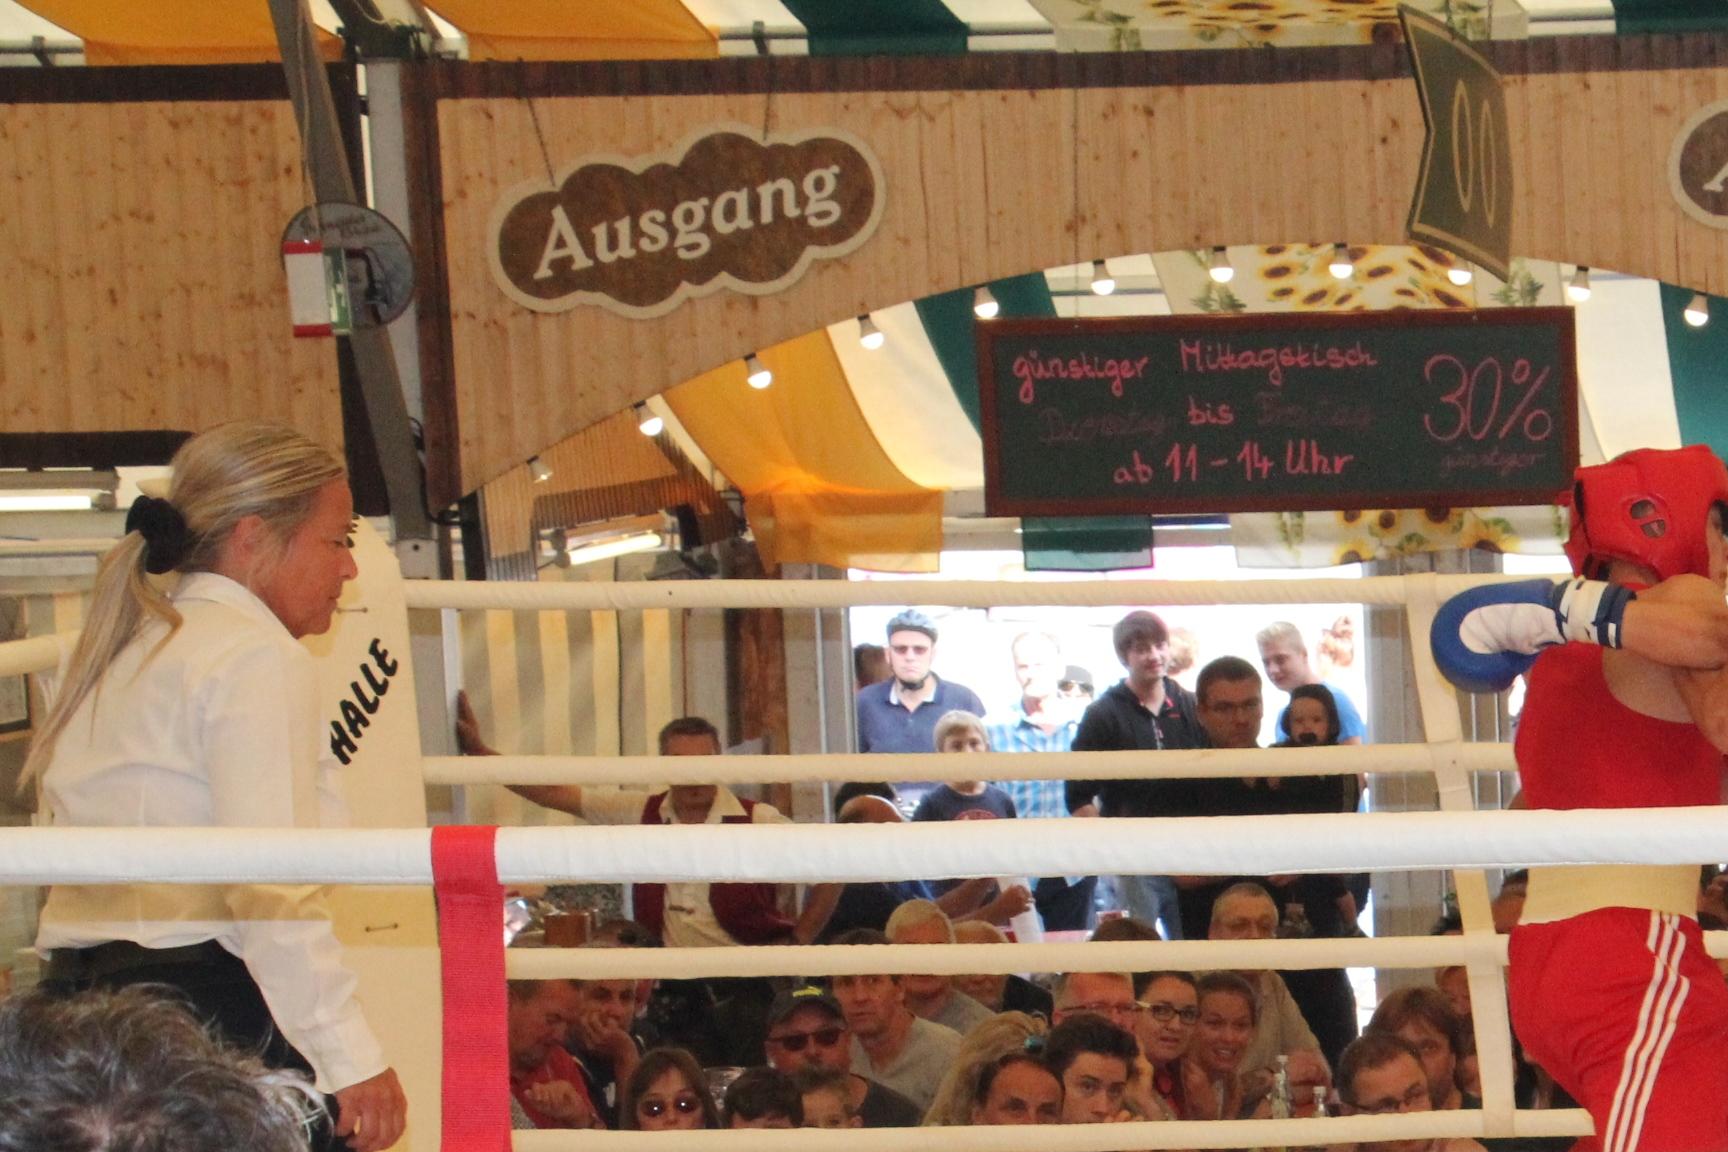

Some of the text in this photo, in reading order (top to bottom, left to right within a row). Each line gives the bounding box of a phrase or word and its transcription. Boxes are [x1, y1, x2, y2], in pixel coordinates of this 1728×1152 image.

[533, 165, 842, 280] Ausgang
[1013, 338, 1377, 404] günstiger Mittagstisch
[1424, 354, 1552, 442] 30%
[1187, 396, 1235, 426] bis
[1113, 450, 1154, 484] ab
[1164, 443, 1198, 482] 11
[1236, 440, 1274, 481] 14
[1285, 439, 1354, 475] Uhr
[330, 637, 398, 765] HALLE
